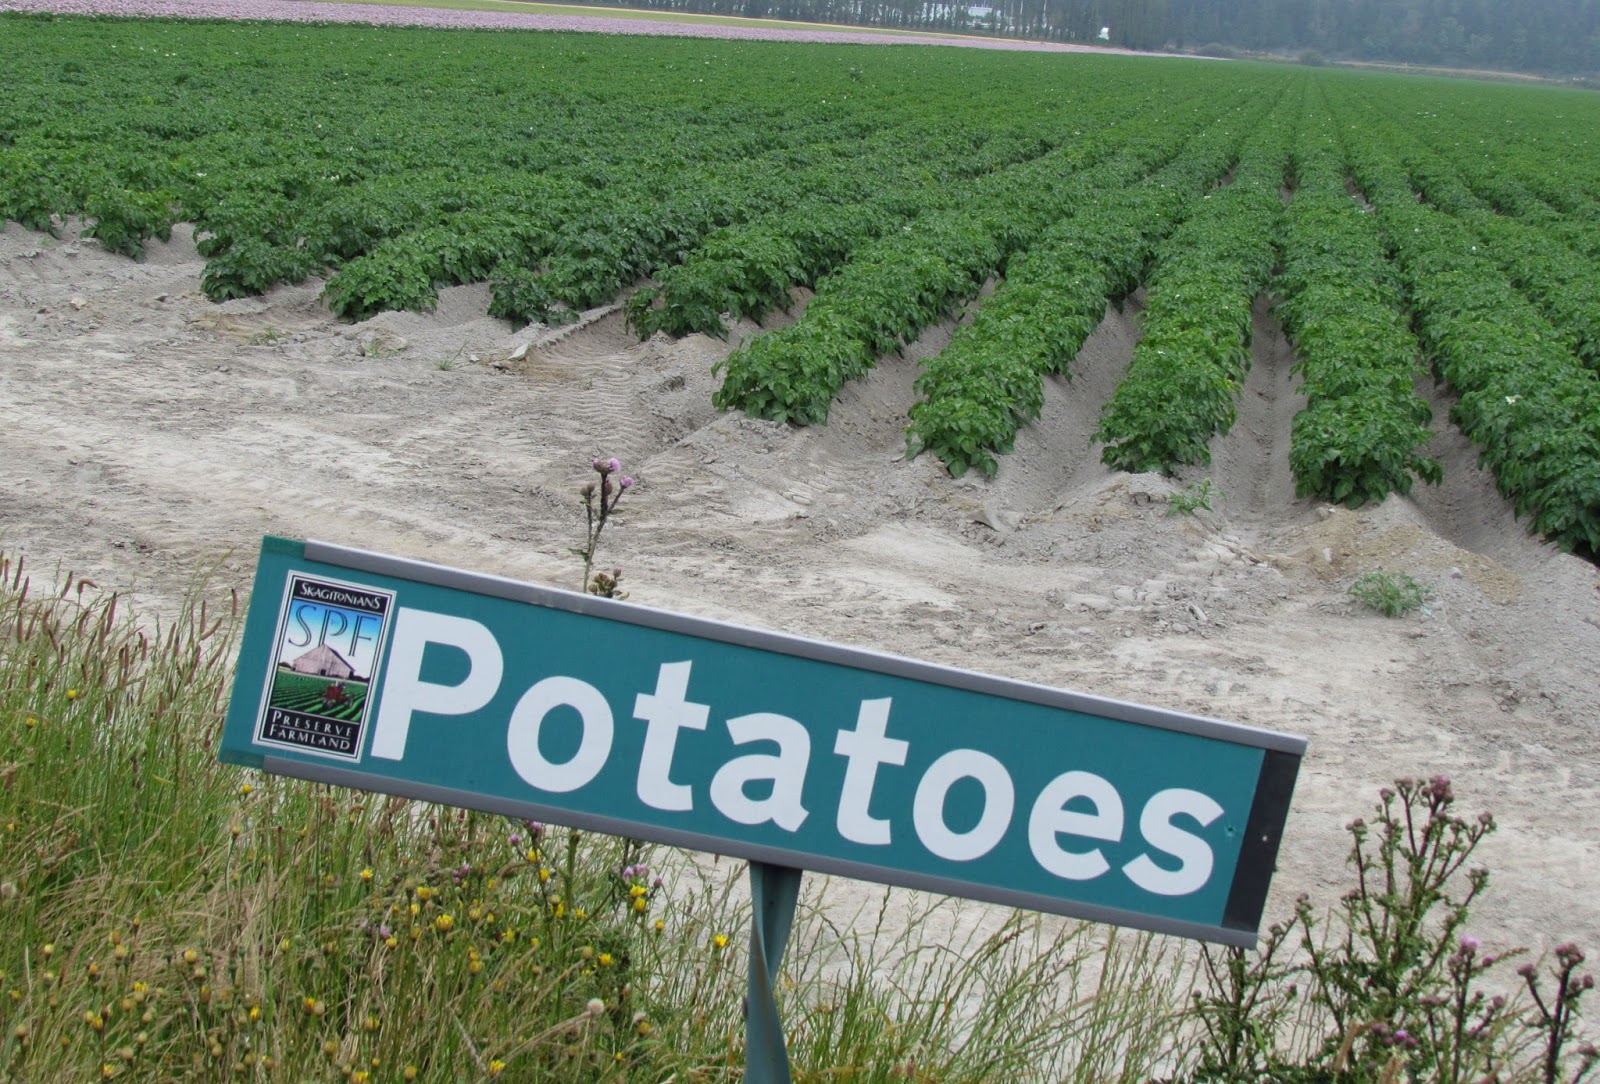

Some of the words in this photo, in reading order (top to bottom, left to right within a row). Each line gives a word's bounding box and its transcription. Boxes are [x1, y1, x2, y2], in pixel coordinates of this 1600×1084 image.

[300, 582, 381, 609] SKAGITONIANS
[288, 605, 378, 657] SPF
[269, 723, 350, 750] FARMLAND
[272, 710, 352, 737] PRESERVE
[371, 606, 1225, 897] Potatoes
